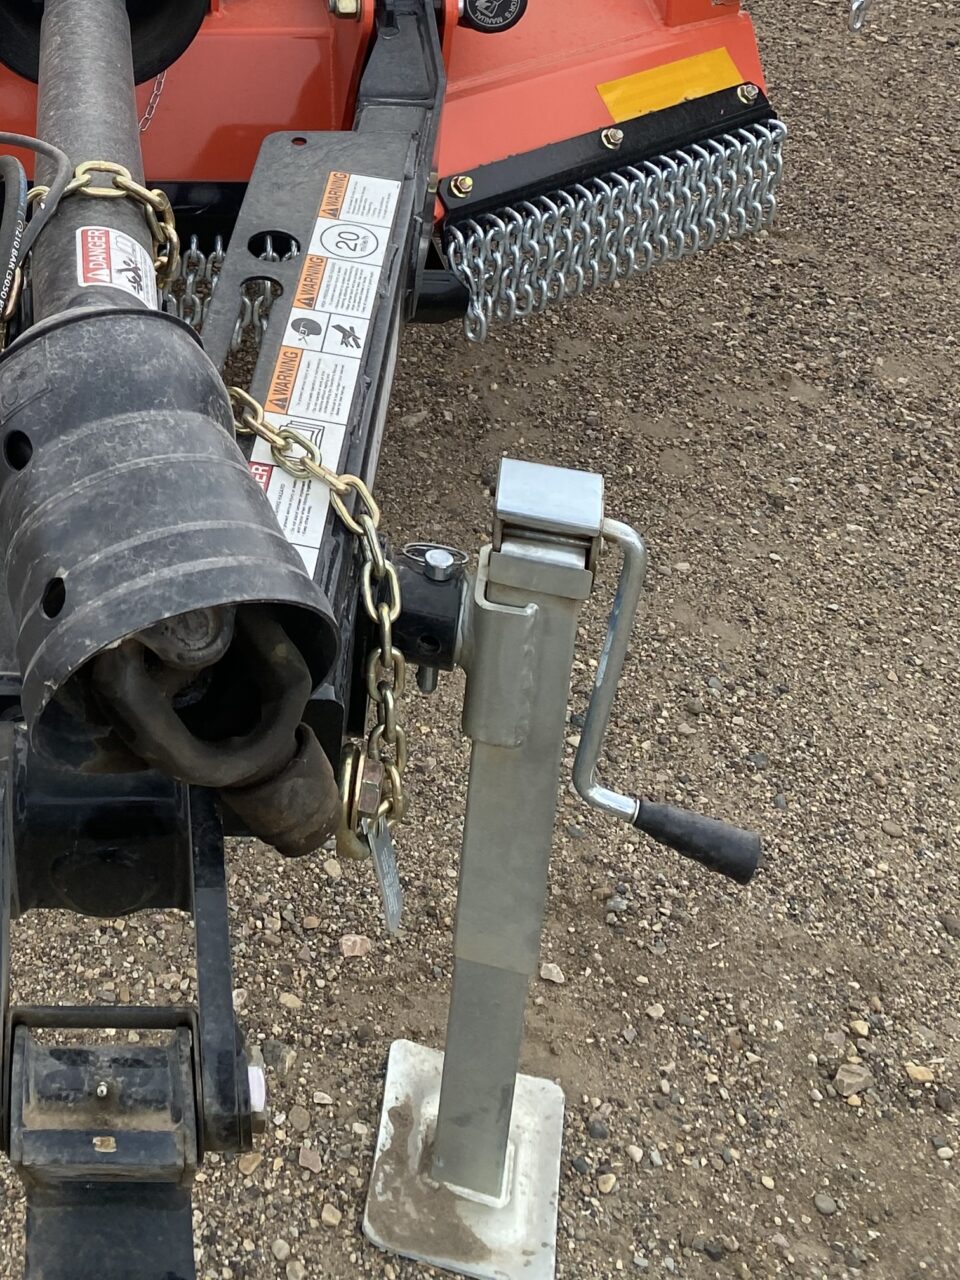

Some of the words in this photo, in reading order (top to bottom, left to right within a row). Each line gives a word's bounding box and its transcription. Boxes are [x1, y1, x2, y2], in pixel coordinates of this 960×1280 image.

[474, 10, 504, 25] MANUAL
[323, 172, 348, 209] WARNING
[87, 229, 107, 269] DANGER
[335, 231, 360, 252] 20
[7, 248, 19, 270] BAR
[0, 270, 14, 299] (3050
[300, 256, 325, 297] WARNING
[278, 350, 299, 397] WARNING
